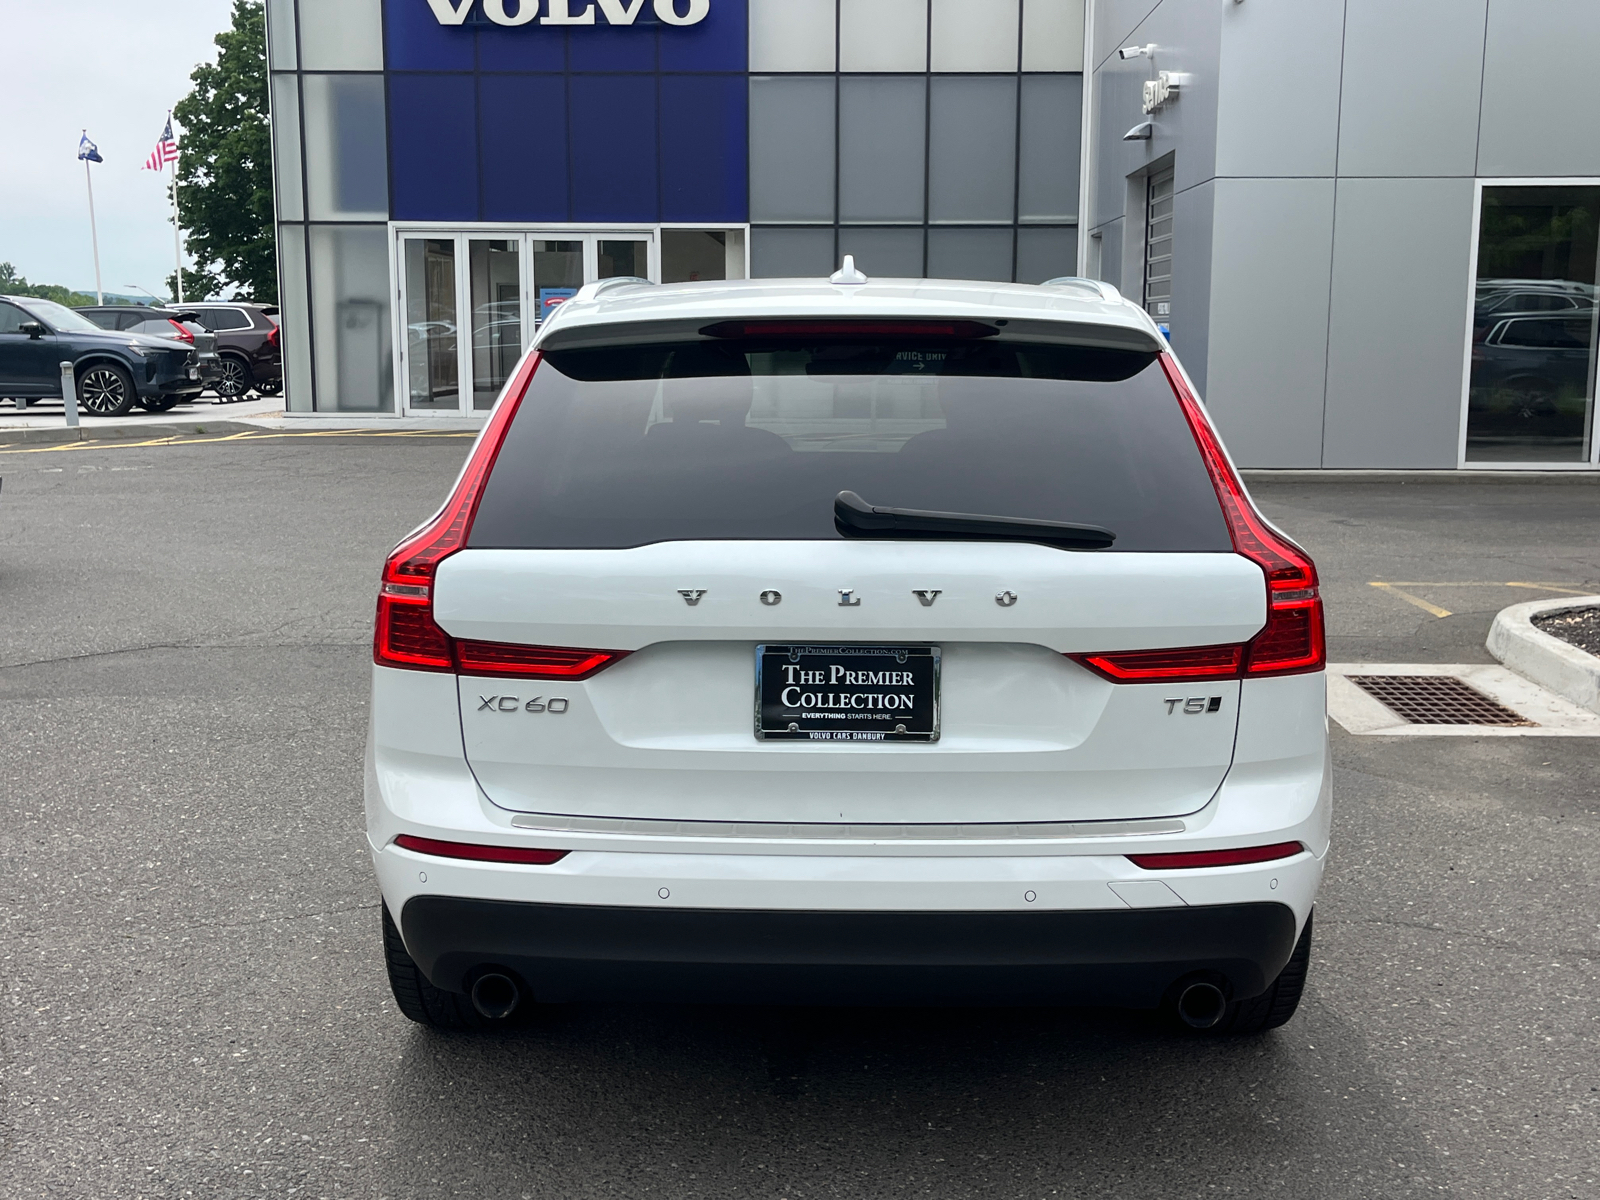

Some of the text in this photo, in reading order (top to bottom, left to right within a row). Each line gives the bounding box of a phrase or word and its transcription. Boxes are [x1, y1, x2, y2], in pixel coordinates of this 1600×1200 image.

[427, 0, 710, 26] VOLVO
[677, 588, 1018, 607] VOLVO
[477, 694, 570, 714] XC60
[1163, 697, 1206, 715] T5
[809, 732, 886, 741] VOLVO CARS DANBURY
